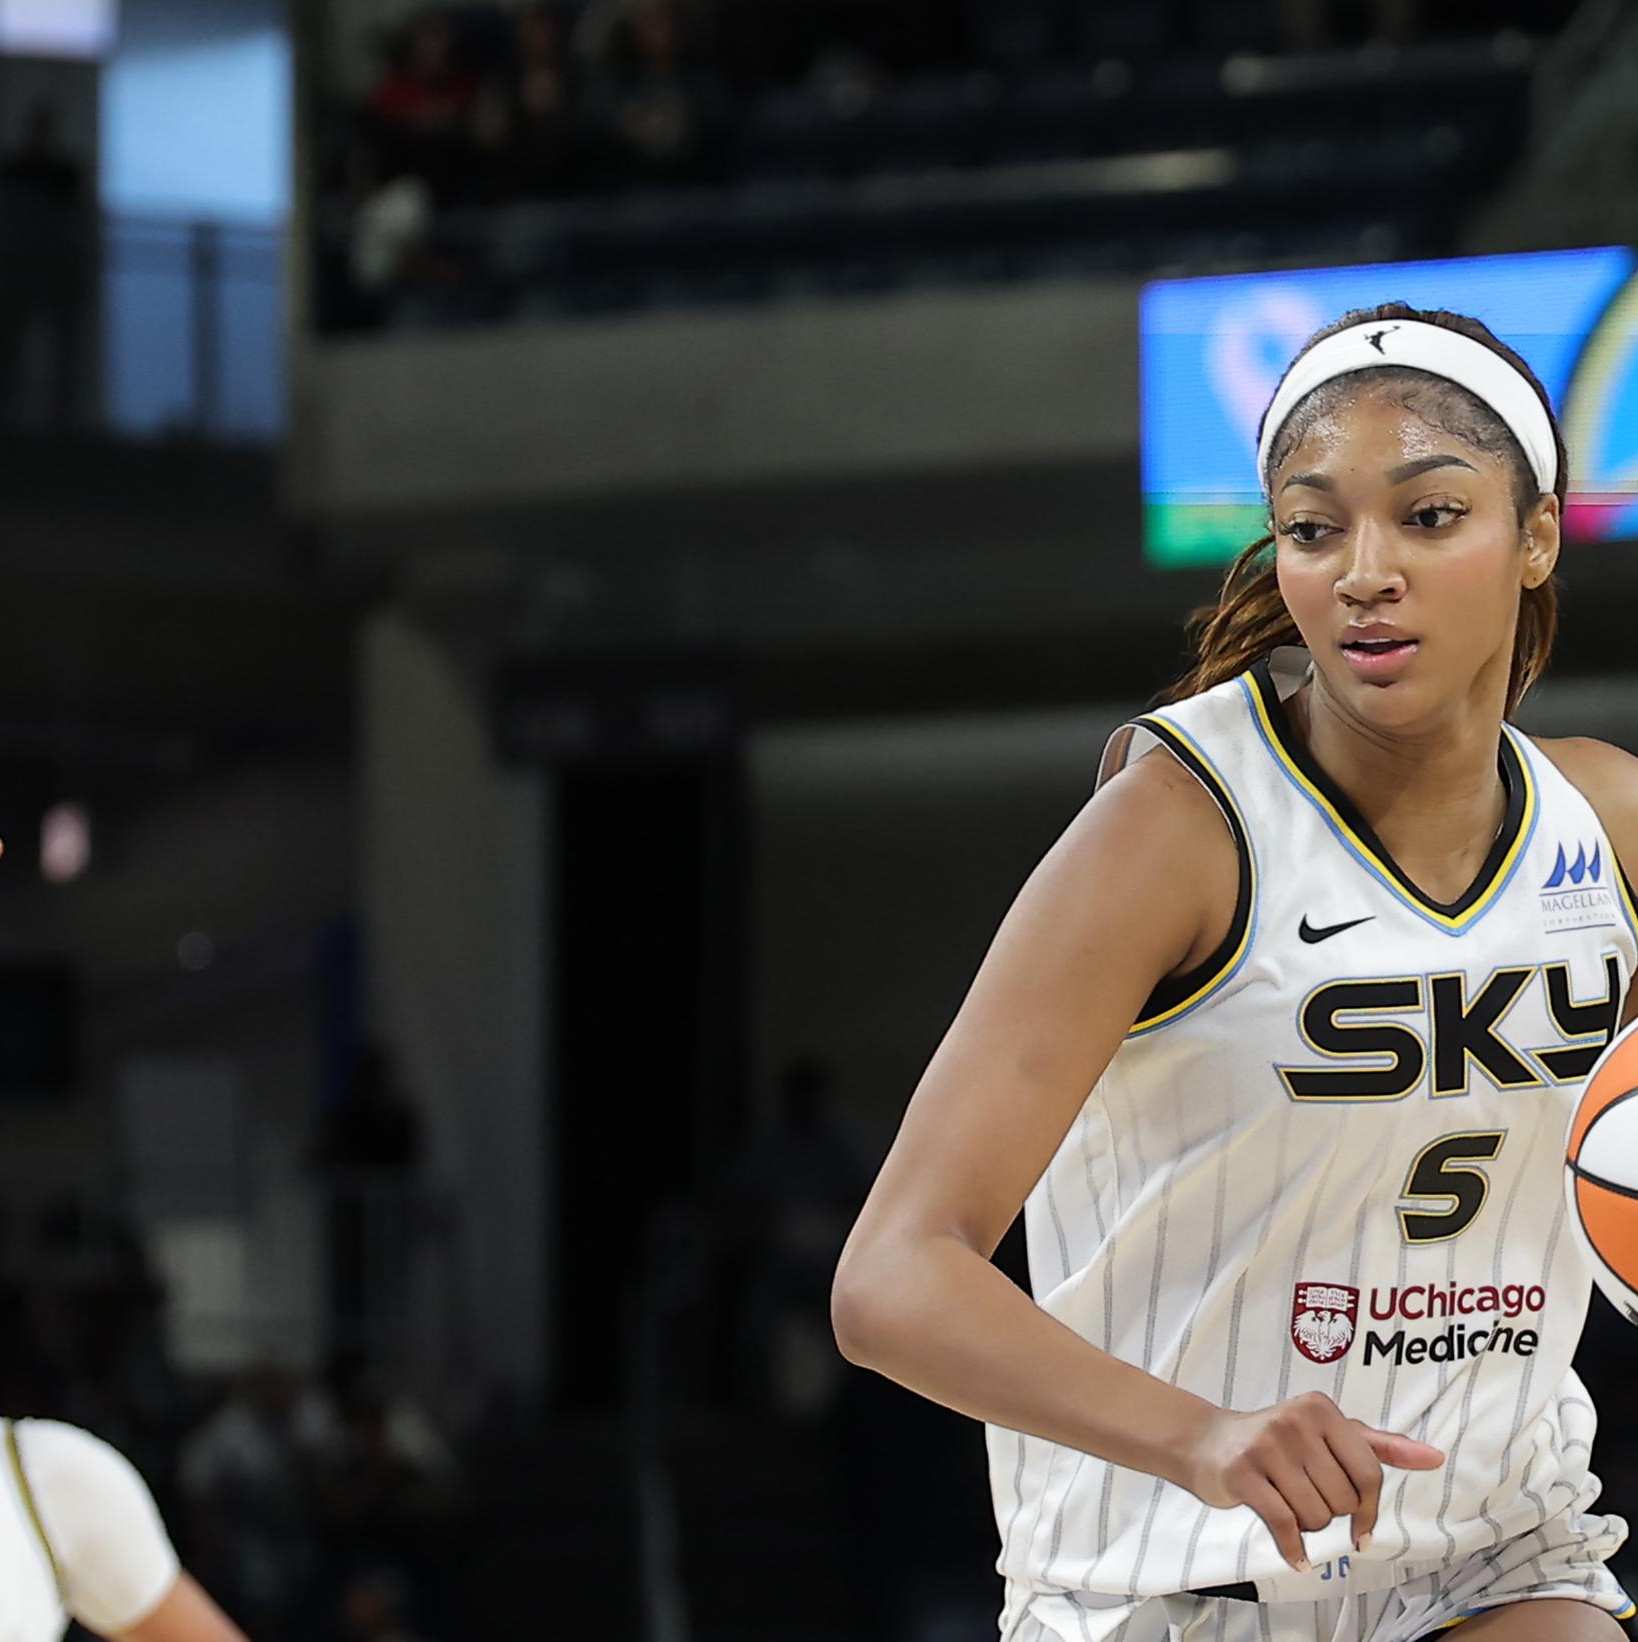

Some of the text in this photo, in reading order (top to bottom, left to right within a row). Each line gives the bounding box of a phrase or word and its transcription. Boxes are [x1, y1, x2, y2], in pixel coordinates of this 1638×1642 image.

[1541, 891, 1612, 913] MAGELLAN
[1273, 952, 1620, 1103] SKY
[1399, 1130, 1509, 1245] 5
[1369, 1281, 1546, 1320] UChicago
[1363, 1320, 1539, 1366] Medicine
